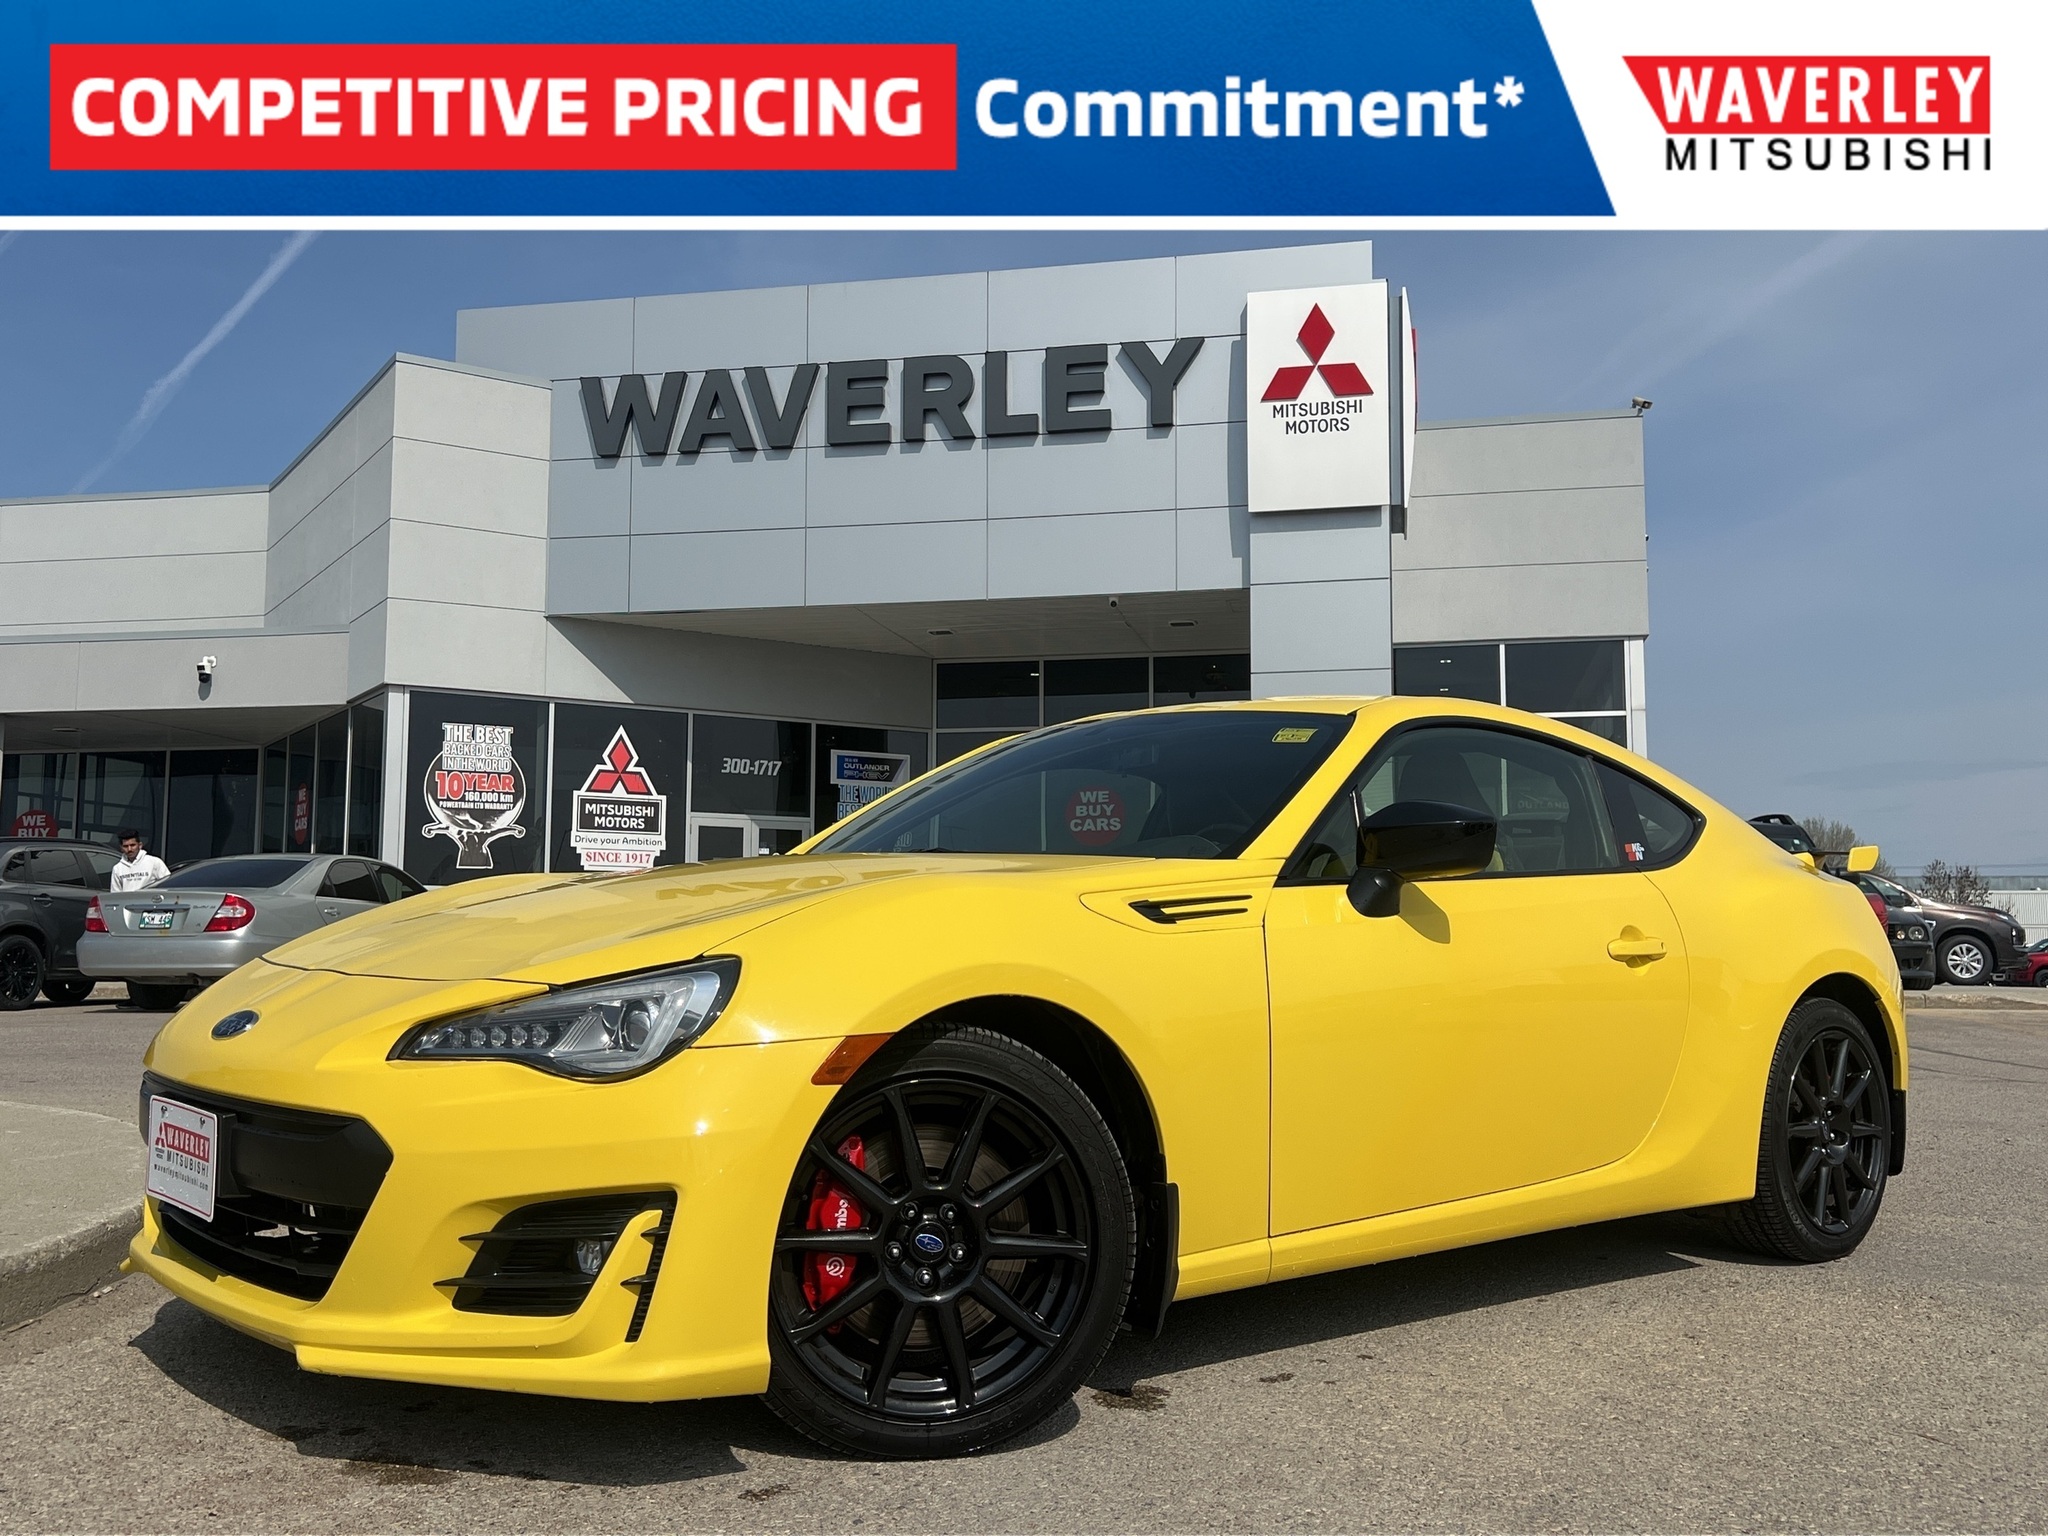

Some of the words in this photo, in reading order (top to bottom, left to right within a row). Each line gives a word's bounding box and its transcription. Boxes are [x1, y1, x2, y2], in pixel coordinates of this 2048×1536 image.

[580, 337, 1205, 458] WAVERLEY
[1272, 399, 1363, 418] MITSUBISHI
[1285, 417, 1350, 435] MOTORS
[443, 724, 473, 743] THE
[475, 726, 513, 745] BEST
[445, 743, 482, 756] BACKED
[485, 745, 511, 757] CARS
[444, 756, 453, 769] IN
[454, 757, 474, 770] THE
[475, 759, 511, 772] WORLD
[721, 757, 783, 776] 300-1717
[843, 762, 890, 772] OUTLANDER
[436, 771, 464, 800] 10
[462, 773, 515, 792] YEAR
[500, 793, 513, 803] km
[839, 785, 859, 803] THE
[1080, 791, 1110, 803] WE
[585, 803, 655, 817] MITSUBISHI
[1075, 804, 1115, 817] BUY
[22, 815, 46, 827] WE
[594, 816, 645, 829] MOTORS
[1070, 818, 1121, 832] CARS
[17, 828, 50, 838] BUY
[575, 835, 598, 844] Drive
[600, 837, 620, 845] your
[622, 837, 663, 846] Ambition
[585, 851, 621, 863] SINCE
[626, 853, 651, 864] 1917
[167, 1126, 209, 1159] WAVERLEY
[167, 1149, 209, 1178] MITSUBISHI
